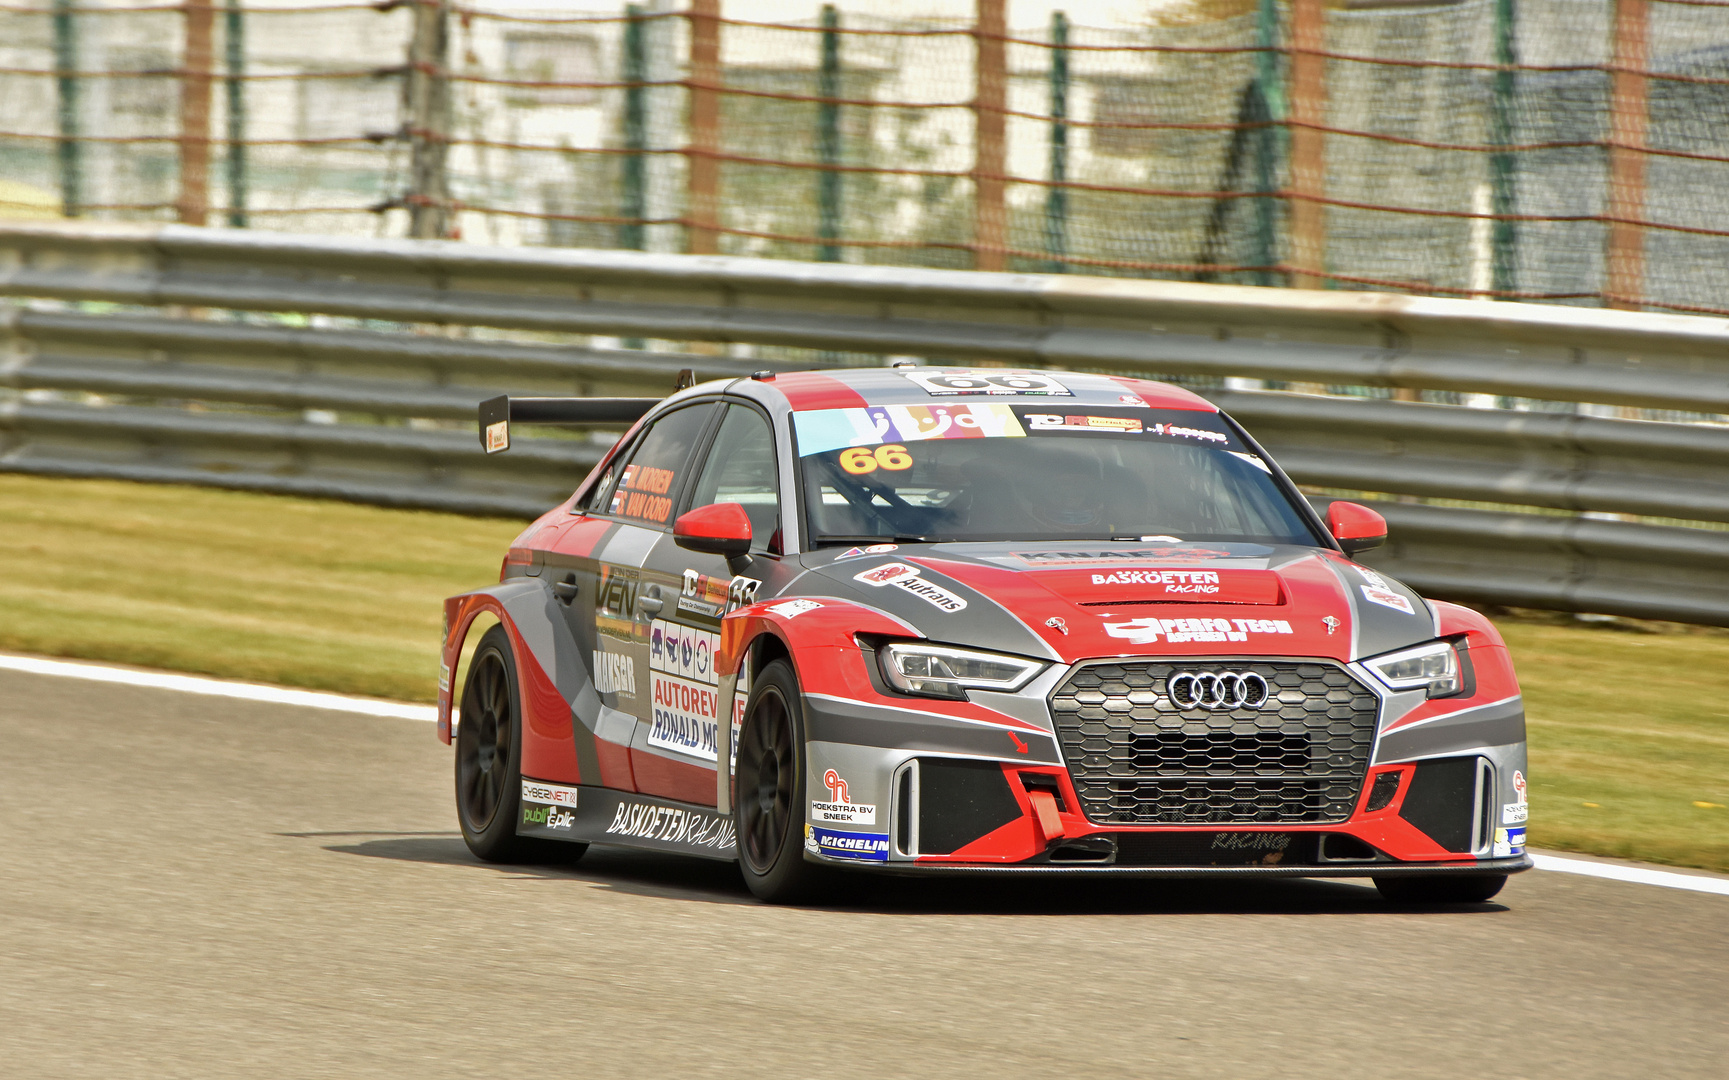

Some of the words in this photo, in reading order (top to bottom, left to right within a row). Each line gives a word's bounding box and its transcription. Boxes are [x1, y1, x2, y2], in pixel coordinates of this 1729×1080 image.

[926, 374, 1049, 389] 66
[839, 444, 913, 475] 66
[626, 492, 647, 517] VAN
[643, 495, 672, 522] OORD
[1092, 571, 1219, 585] BASKOETEN
[897, 577, 961, 611] Autrans
[1165, 584, 1219, 594] RACING
[1159, 618, 1232, 633] PERFO
[1231, 619, 1293, 634] TECH
[652, 708, 700, 749] RONALD
[812, 803, 857, 813] HOEKSTRA
[859, 806, 873, 814] BV
[823, 813, 853, 821] SNEEK
[820, 835, 889, 851] MICHELIN
[1211, 832, 1292, 850] RACING
